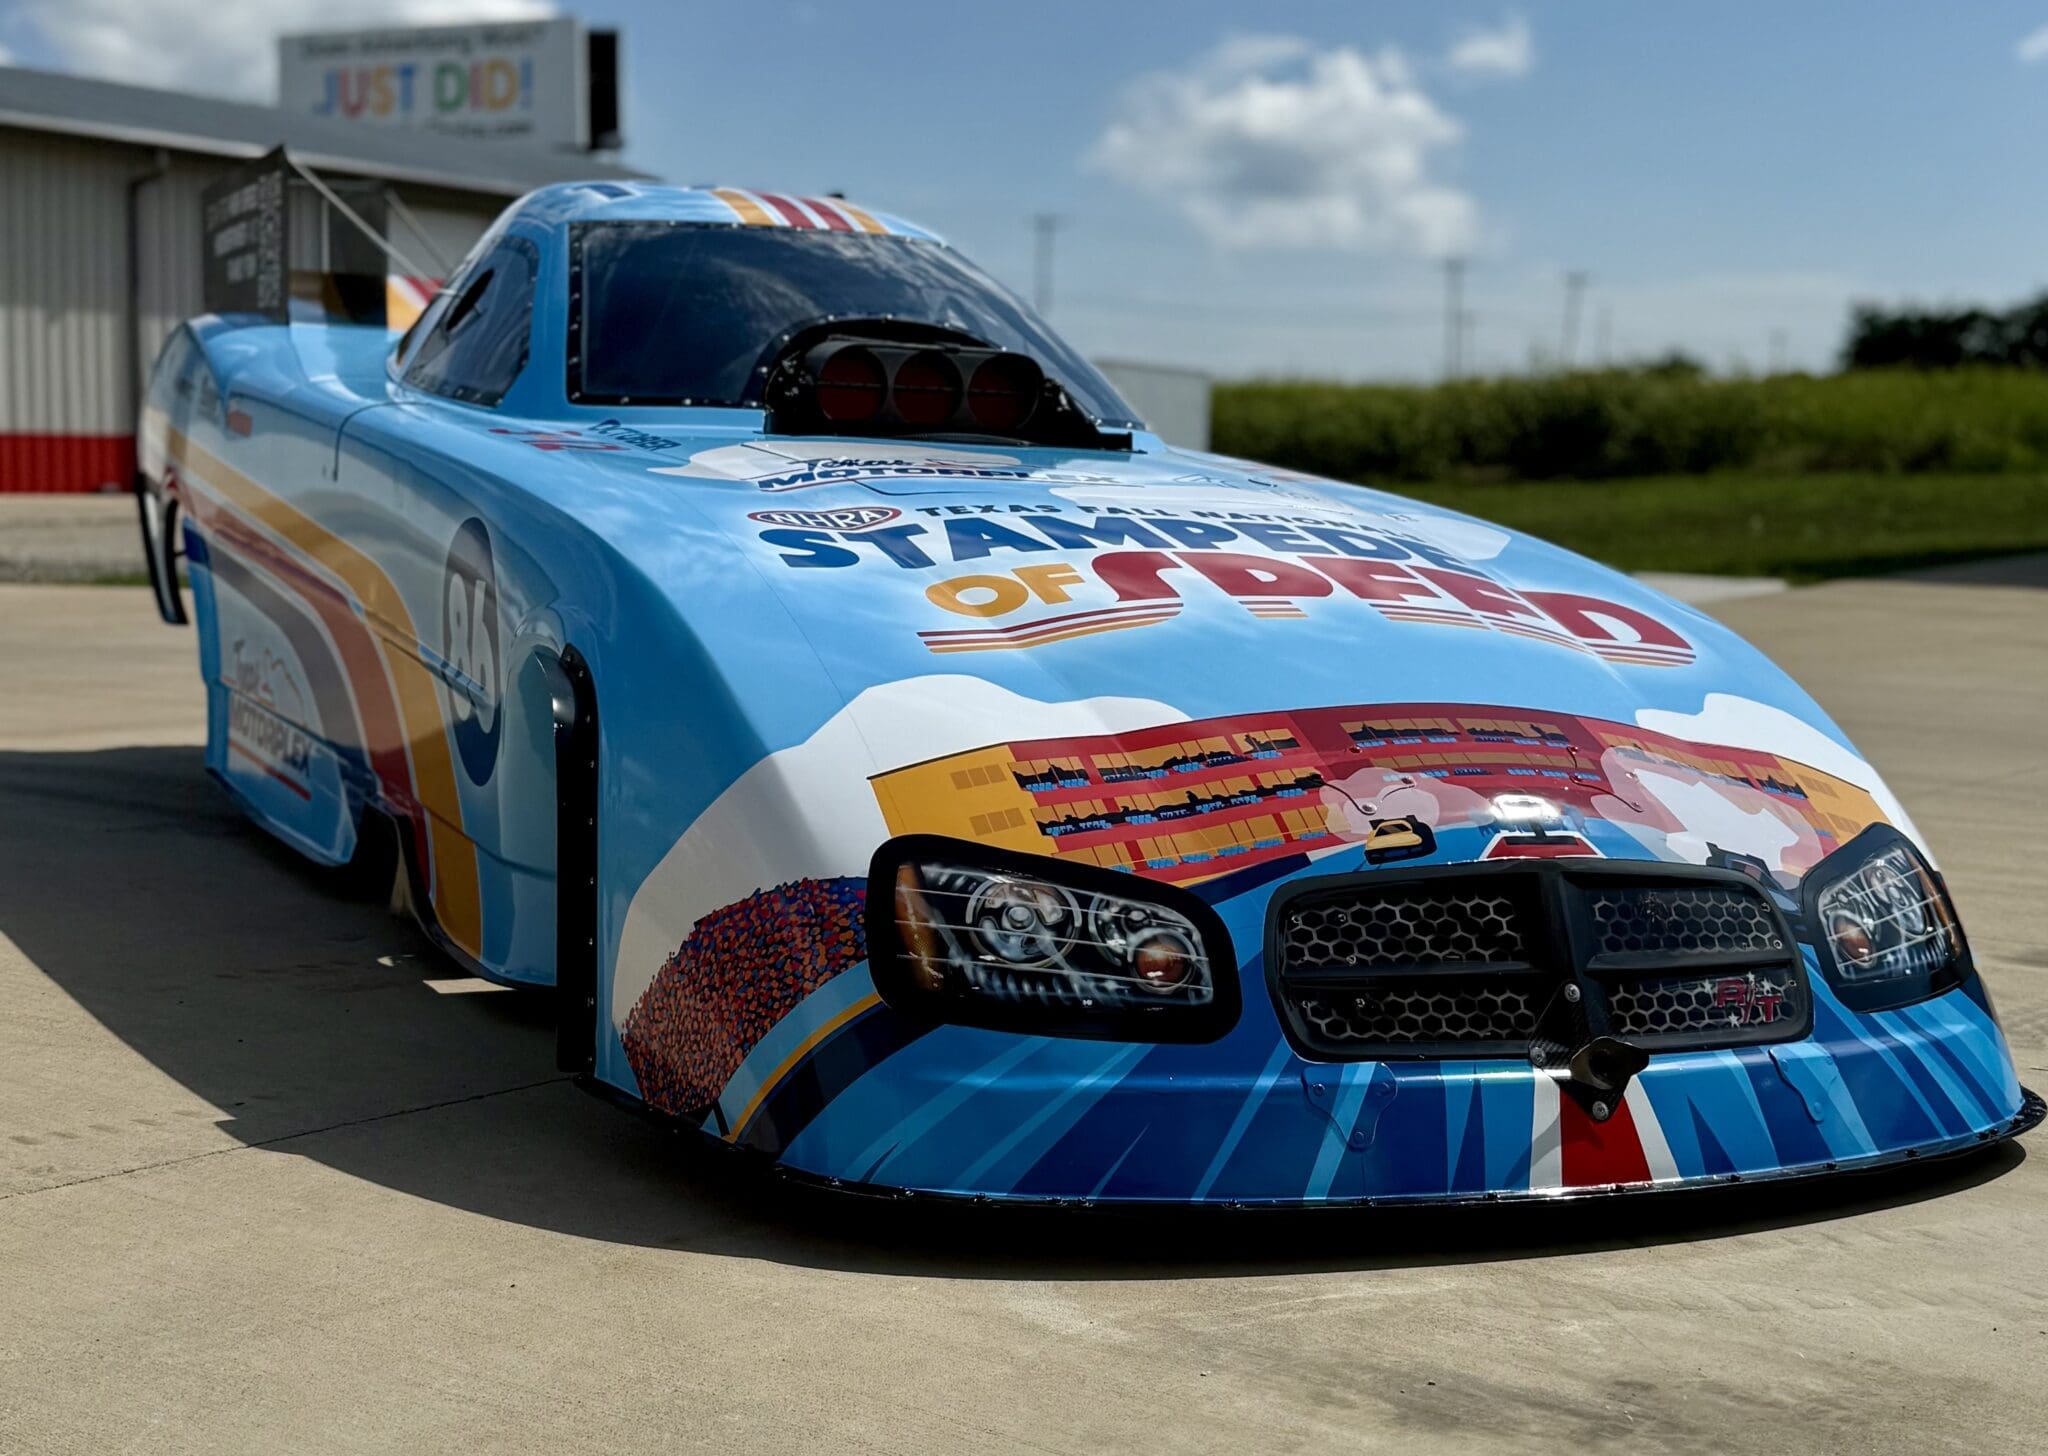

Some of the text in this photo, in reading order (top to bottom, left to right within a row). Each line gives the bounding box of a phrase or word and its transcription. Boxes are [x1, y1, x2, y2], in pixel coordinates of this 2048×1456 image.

[312, 57, 534, 121] JUST DID!
[757, 467, 1123, 491] MOTORPLEX
[768, 508, 886, 530] NHRA
[916, 504, 1063, 517] TEXAS
[1076, 505, 1178, 518] FALL
[757, 515, 1497, 582] STAMPEDE
[925, 550, 1697, 667] OF SPEED
[449, 573, 496, 735] 86
[1714, 976, 1783, 1025] R/T
